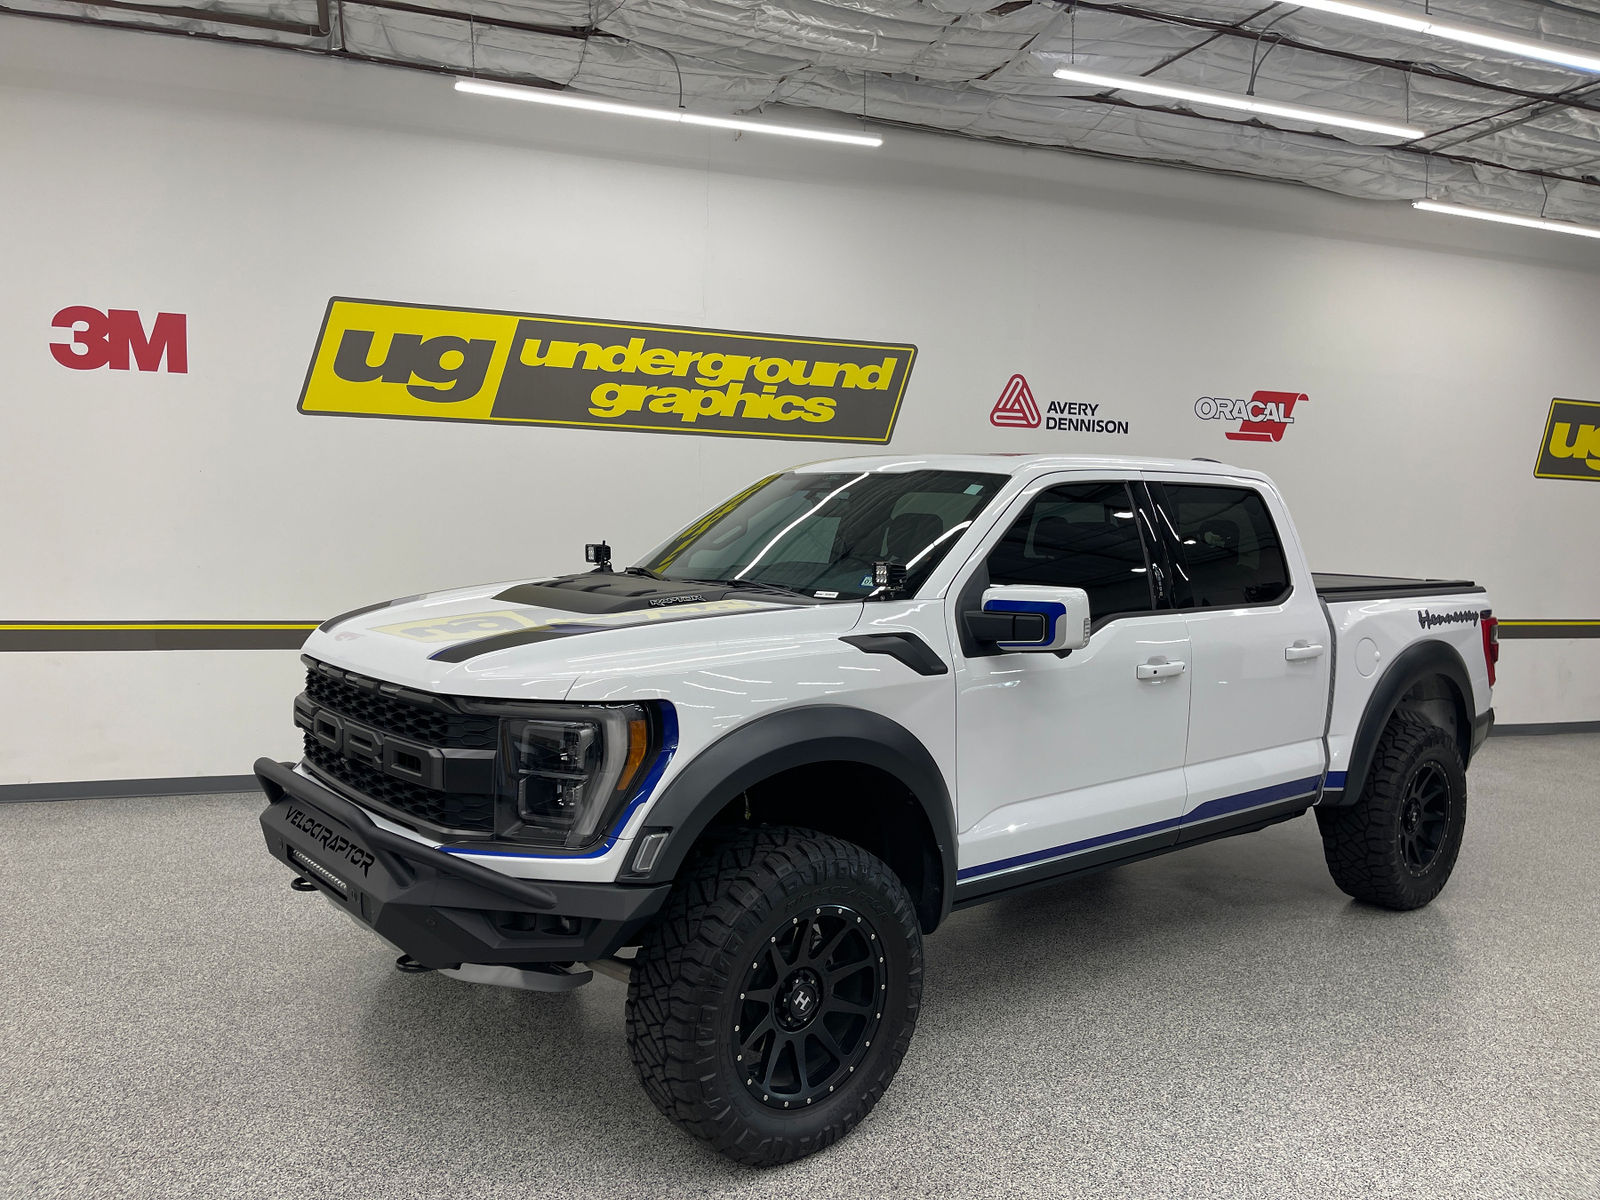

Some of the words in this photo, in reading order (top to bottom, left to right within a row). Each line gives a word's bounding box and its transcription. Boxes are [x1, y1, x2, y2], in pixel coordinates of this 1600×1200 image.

[49, 305, 188, 374] 3M
[333, 329, 497, 403] ug
[520, 338, 898, 391] underground
[588, 382, 837, 423] graphics
[1046, 417, 1129, 434] DENNISON
[1047, 401, 1100, 416] AVERY
[1194, 396, 1295, 424] ORACAL
[284, 805, 376, 878] VELOCIRAPTOR
